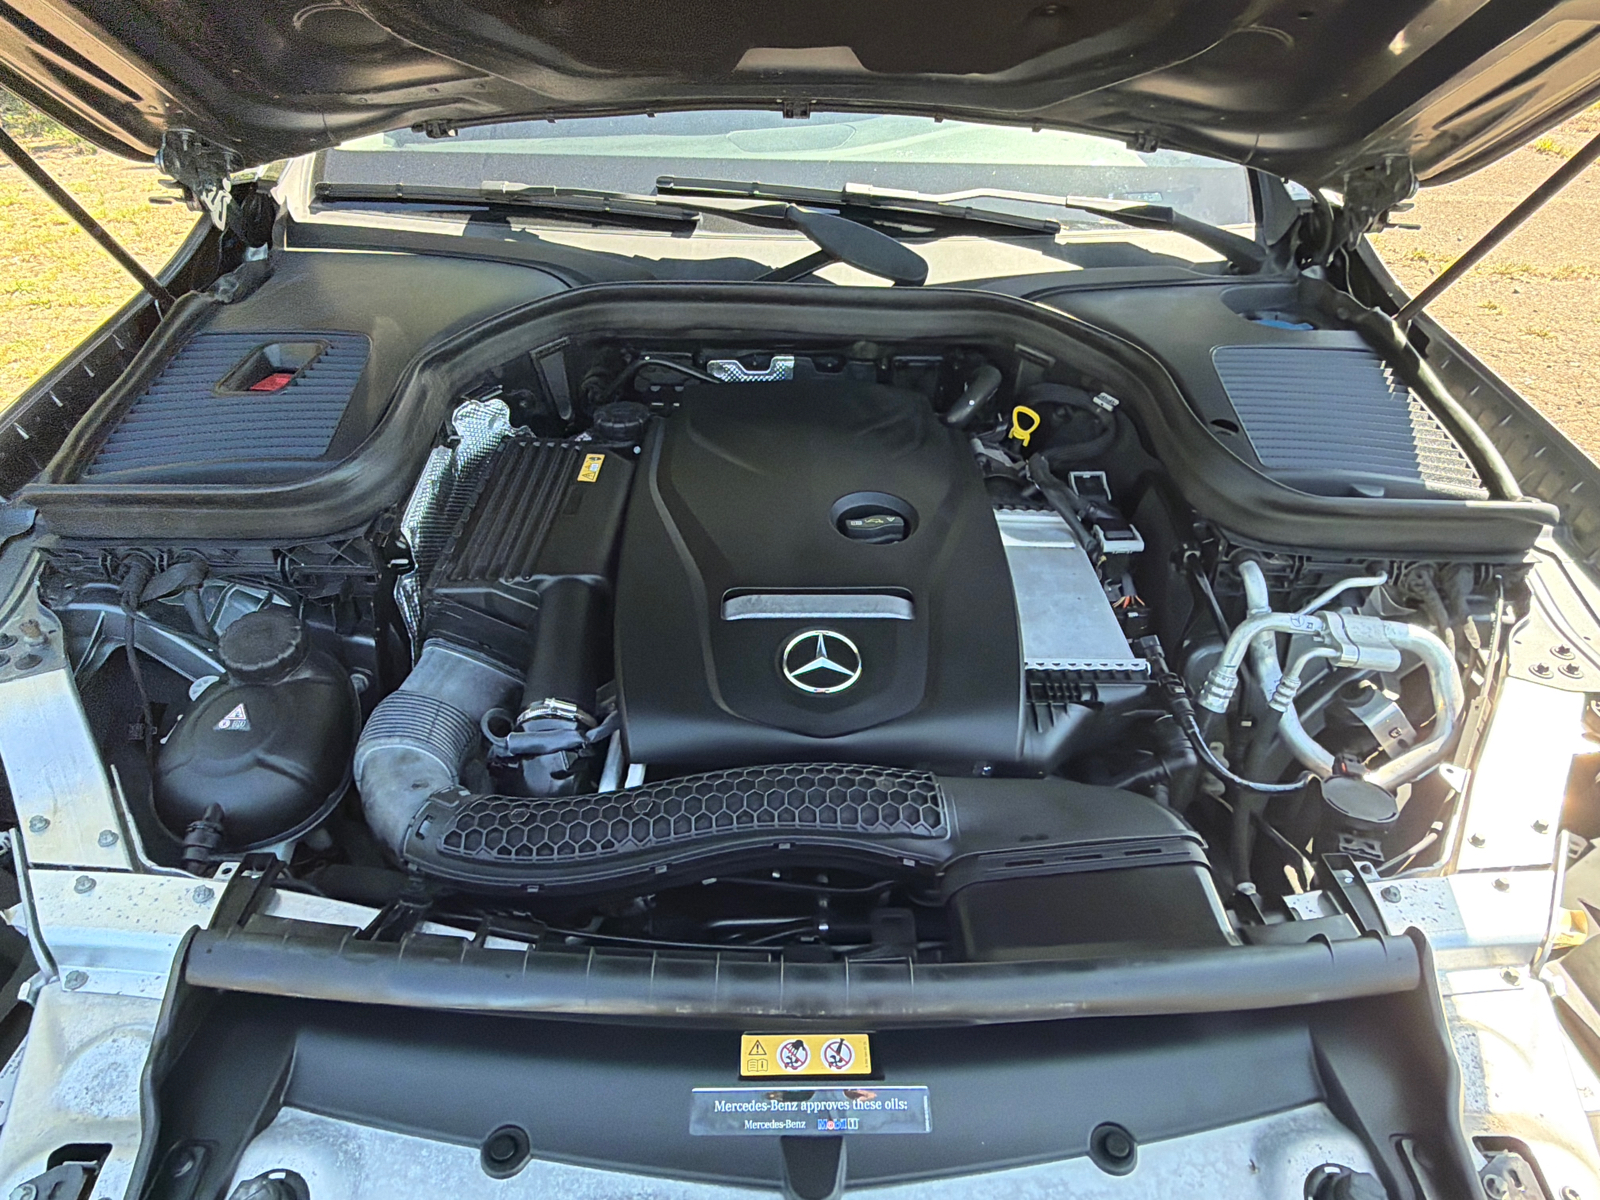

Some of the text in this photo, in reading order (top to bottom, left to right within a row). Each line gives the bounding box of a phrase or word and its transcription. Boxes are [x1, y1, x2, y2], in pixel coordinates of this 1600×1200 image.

[714, 1097, 908, 1114] Mercedes-Benz approves these oils:
[744, 1119, 806, 1130] Mercedes-Benz
